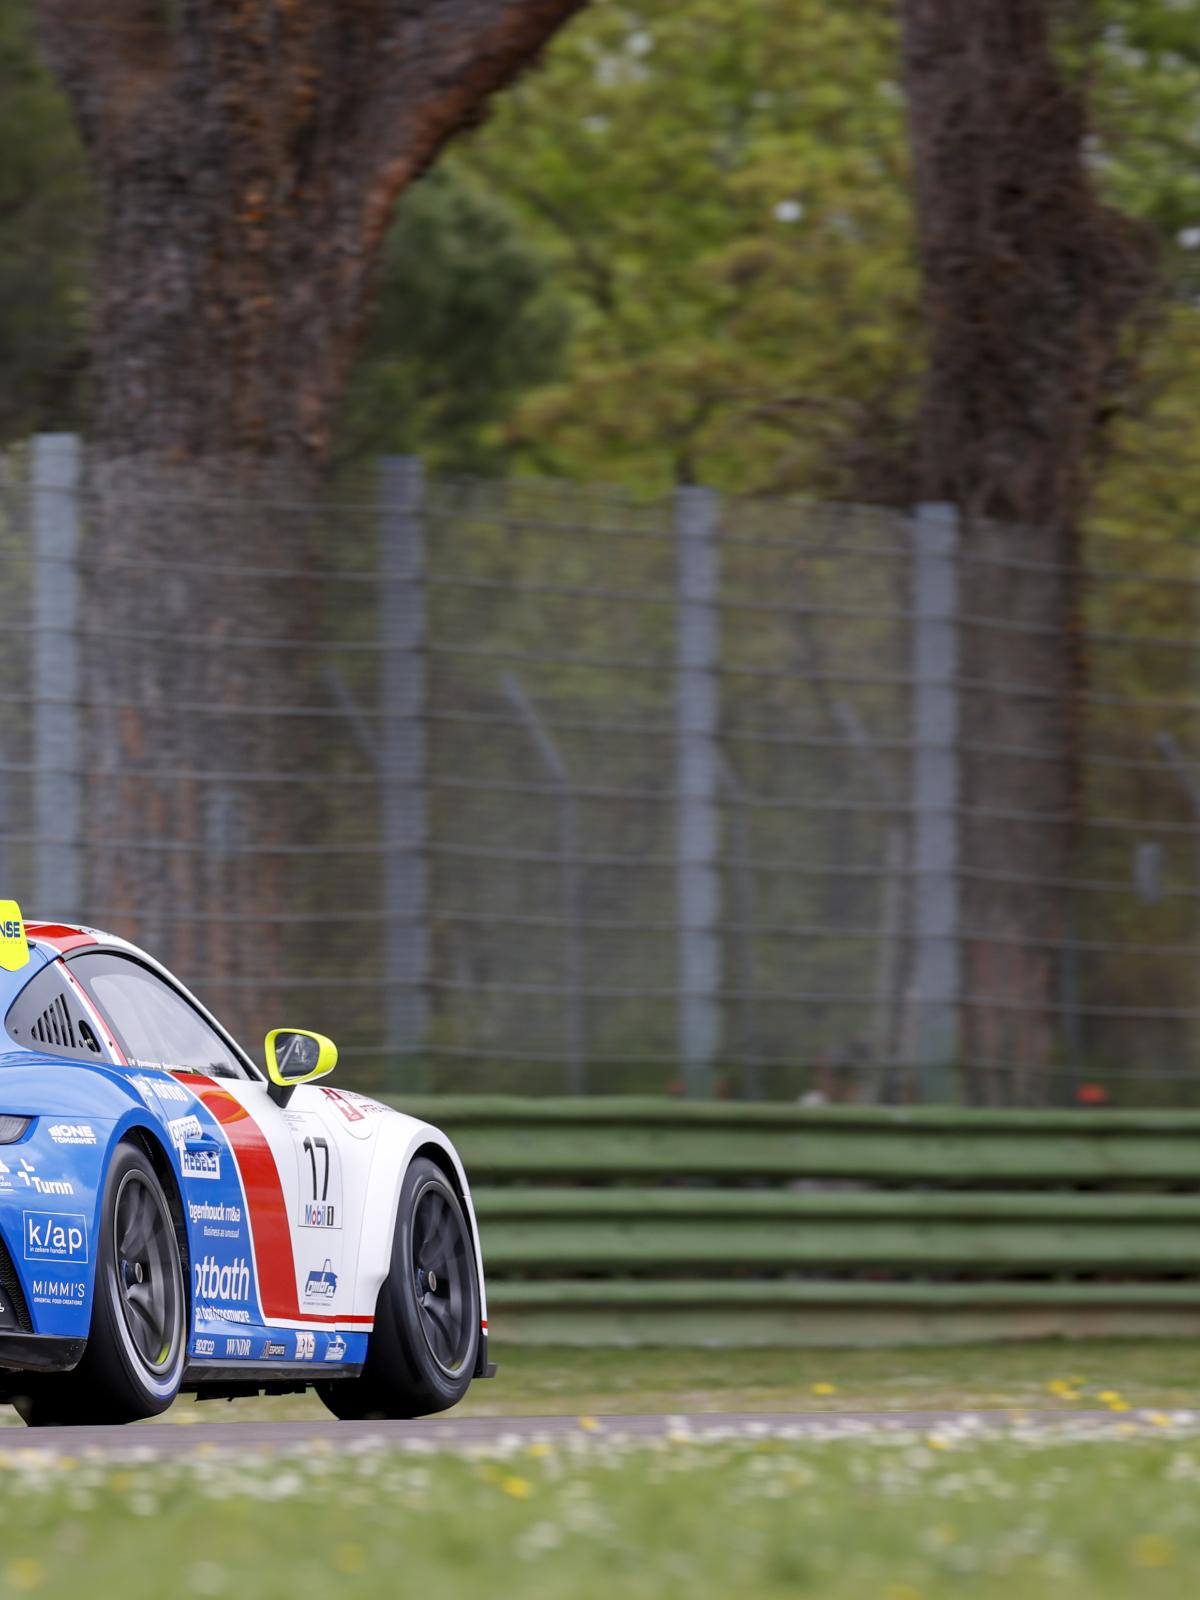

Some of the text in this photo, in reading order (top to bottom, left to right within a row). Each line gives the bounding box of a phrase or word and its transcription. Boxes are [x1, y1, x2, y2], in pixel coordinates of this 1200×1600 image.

[303, 1136, 329, 1201] 17
[305, 1204, 326, 1226] Mobil
[33, 1280, 85, 1298] MIMMI'S
